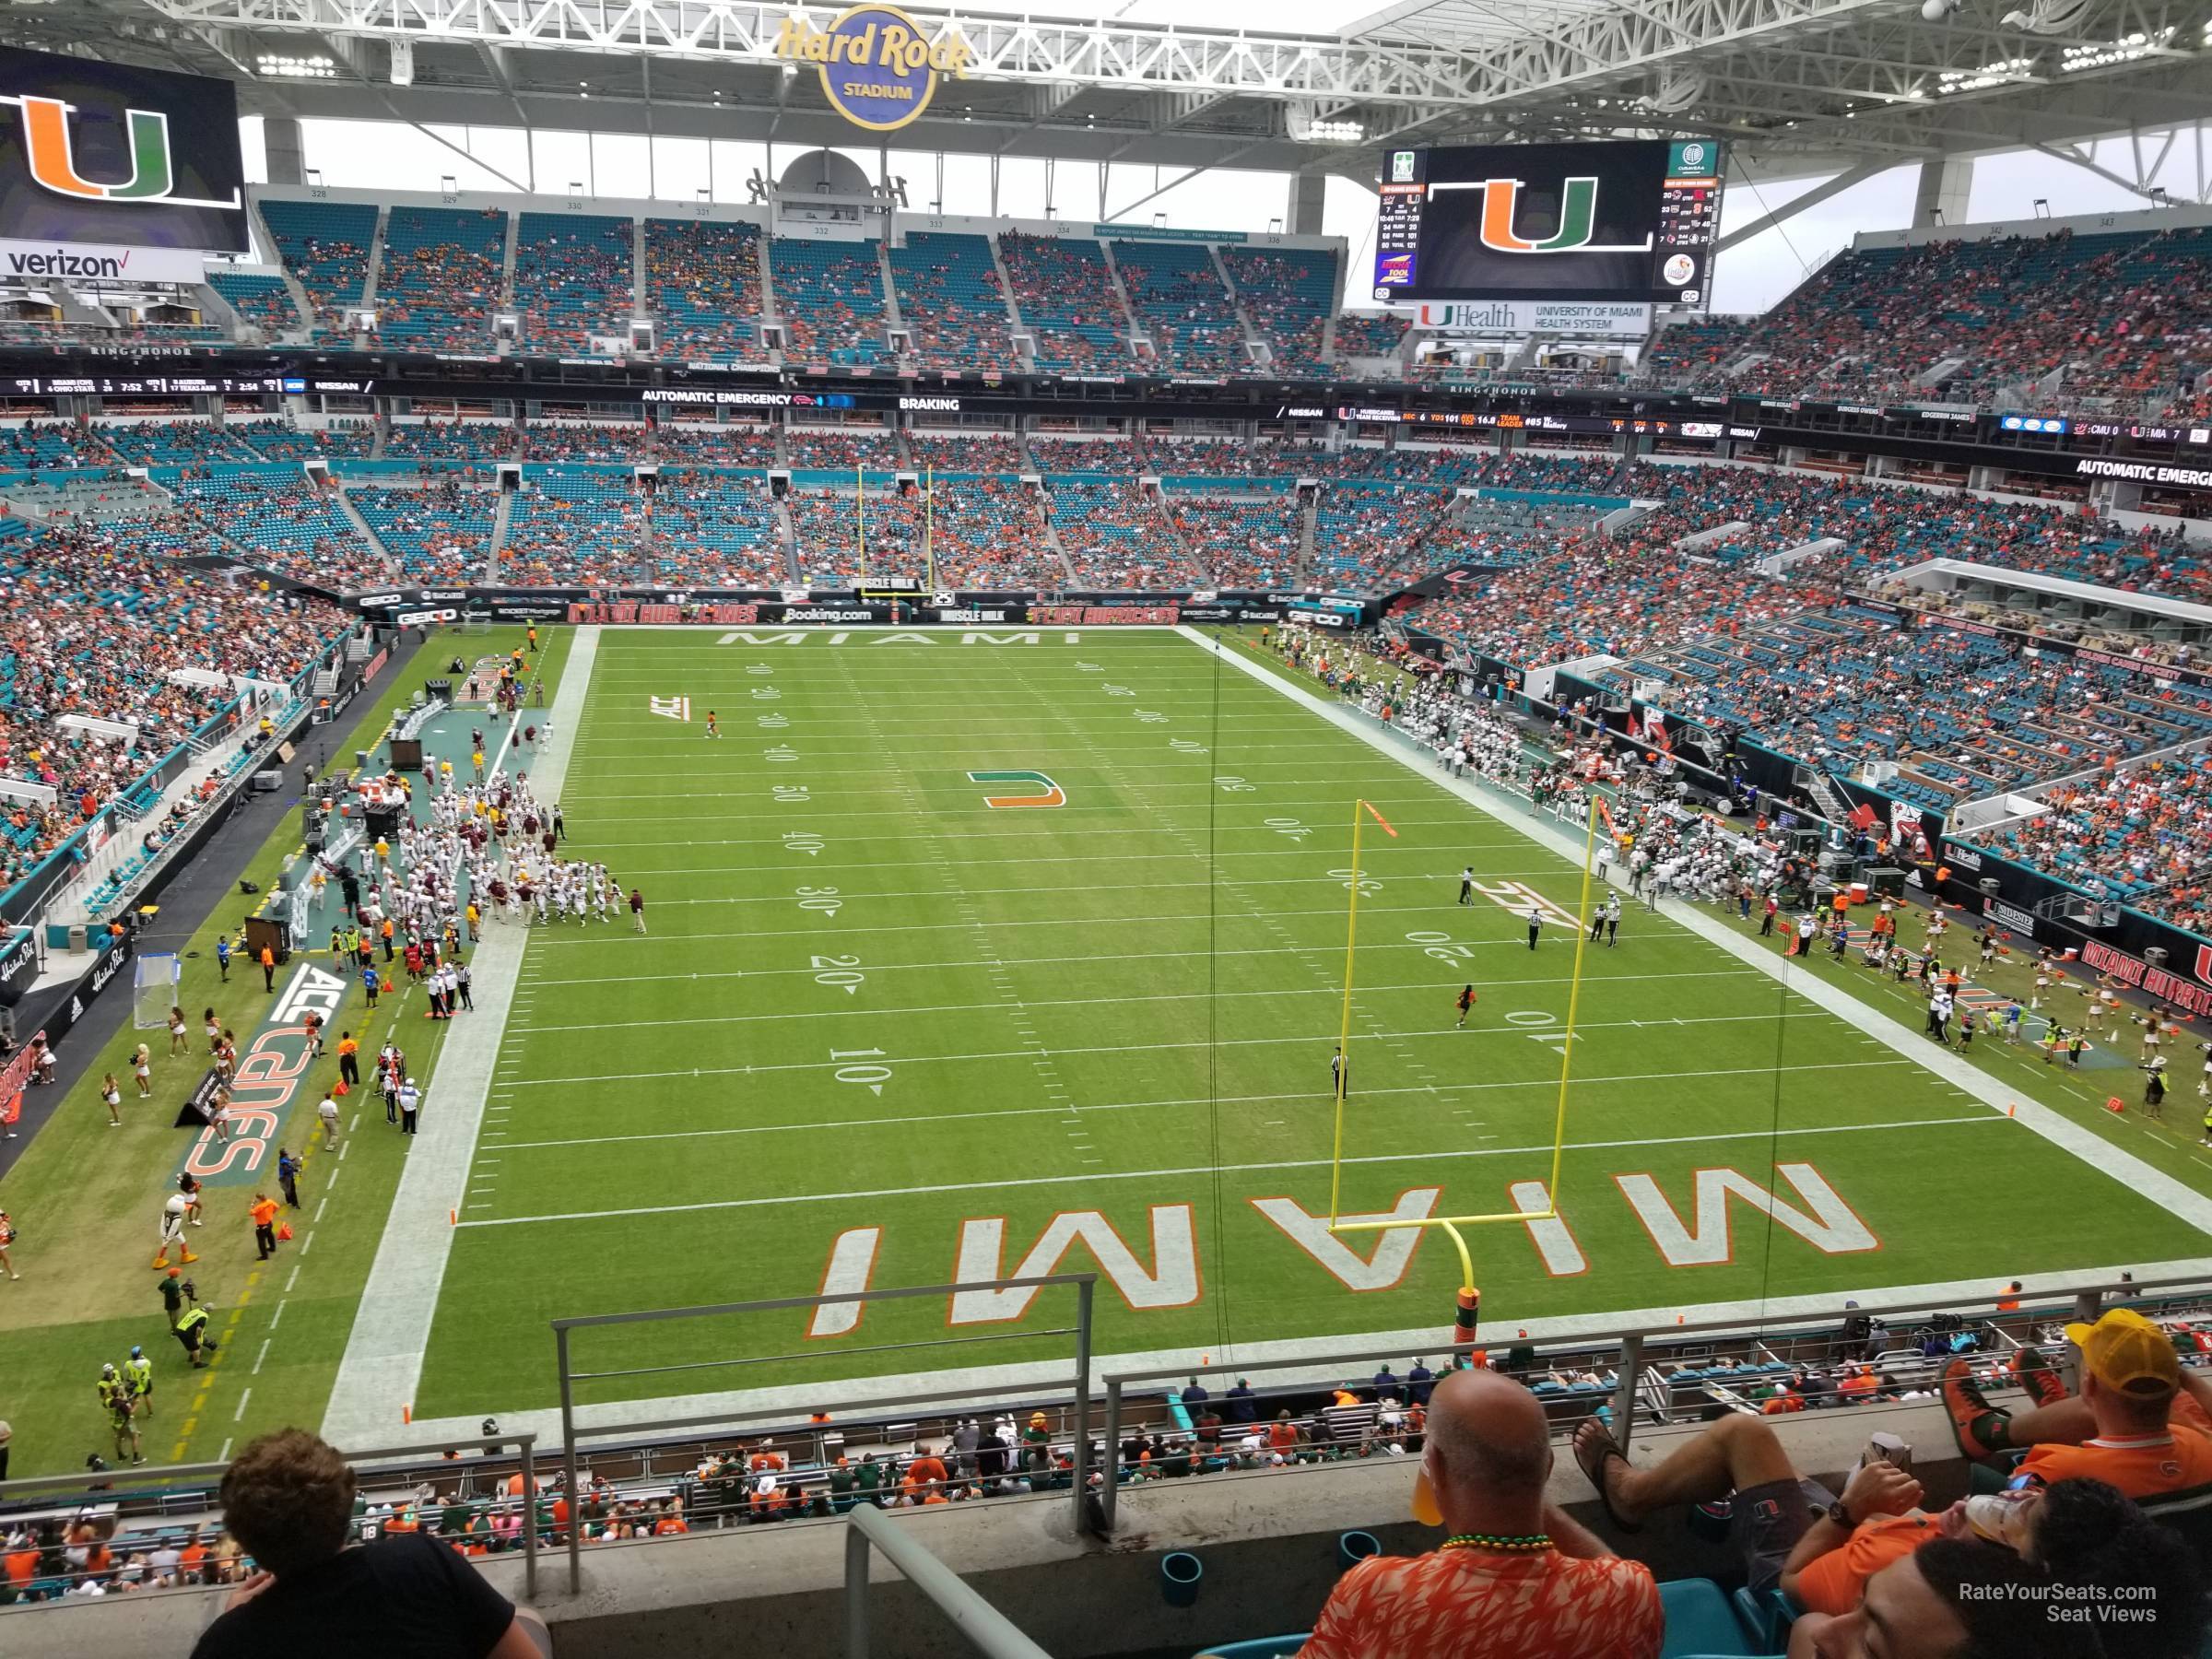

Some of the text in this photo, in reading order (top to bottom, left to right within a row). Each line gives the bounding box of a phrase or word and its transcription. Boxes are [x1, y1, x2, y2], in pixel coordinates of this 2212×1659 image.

[777, 18, 972, 79] Hard Rock
[843, 82, 913, 100] STADIUM
[312, 190, 327, 198] 328
[441, 195, 458, 204] 329
[567, 202, 582, 210] 330
[2100, 218, 2114, 227] 343
[1267, 236, 1281, 245] 336
[8, 249, 119, 277] verizon
[1683, 292, 1697, 300] CC
[1535, 306, 1643, 318] UNIVERSITY OF MIAMI
[1535, 318, 1613, 329] HEALTH SYSTEM
[90, 347, 193, 356] RING HONOR
[688, 362, 782, 373] NATIONAL CHAMPIONS
[121, 382, 143, 393] 7:52
[239, 382, 258, 392] 2:54
[315, 382, 359, 391] NISSAN
[1450, 385, 1536, 396] RING HONOR
[642, 390, 792, 405] AUTOMATIC EMERGENCY
[899, 397, 959, 411] BRAKING
[1288, 408, 1324, 417] NISSAN
[1950, 413, 1971, 421] JAMES
[1445, 415, 1459, 423] 101
[1477, 416, 1495, 425] 16.8
[1524, 418, 1542, 426] #85
[1543, 421, 1567, 429] Mallory
[1730, 428, 1755, 437] NISSAN
[2091, 425, 2180, 439] CMU 0 MIA 7
[2077, 460, 2156, 480] AUTOMATIC
[851, 578, 916, 589] MUSCLE MILK
[359, 594, 402, 606] GEICO
[1320, 597, 1366, 608] GEICO
[397, 608, 457, 626] GEICO
[786, 607, 872, 621] Booking.com
[940, 610, 1006, 621] MUSCLE MILK
[715, 633, 1079, 644] MIAMI
[746, 665, 774, 675] 10
[1076, 662, 1105, 672] 10
[2141, 663, 2182, 680] SOCIETY
[751, 688, 782, 700] 20
[1101, 683, 1135, 697] 20
[757, 715, 790, 728] 30
[1134, 709, 1169, 724] 30
[1169, 739, 1209, 755] 40
[764, 748, 799, 762] 40
[1213, 776, 1256, 793] 50
[771, 785, 811, 802] 50
[1264, 818, 1313, 837] 40
[782, 830, 825, 851] 40
[1326, 868, 1383, 892] 30
[795, 886, 843, 910] 30
[1998, 902, 2034, 927] SYLVESTER
[1405, 931, 1475, 960] 20
[2081, 939, 2146, 985] MIAMI
[811, 955, 865, 984] 20
[1503, 1011, 1585, 1042] 10
[830, 1047, 892, 1082] 10
[804, 1162, 1884, 1340] MIAMI
[362, 1526, 376, 1539] 18
